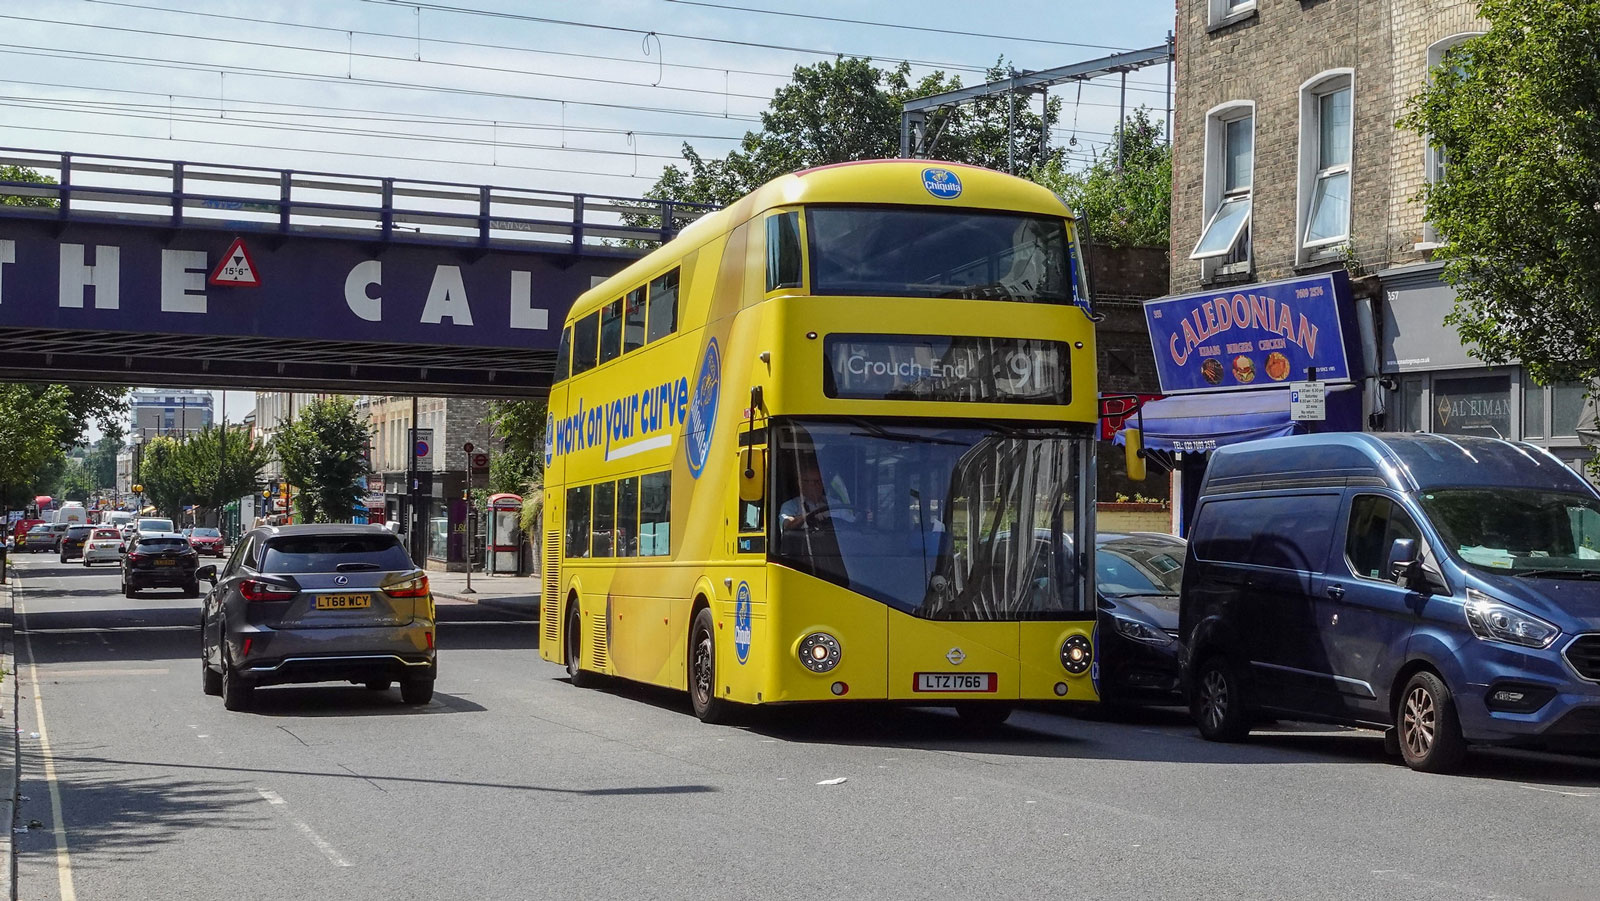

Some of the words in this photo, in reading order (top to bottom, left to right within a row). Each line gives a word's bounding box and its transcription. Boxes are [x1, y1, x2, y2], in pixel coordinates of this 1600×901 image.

[925, 181, 961, 193] Chiquita
[345, 260, 608, 330] CAL
[1170, 294, 1318, 366] CALEDONIAN
[1226, 341, 1253, 354] BURGERS
[1258, 338, 1286, 351] CHICKEN
[848, 355, 922, 377] Crouch
[930, 358, 968, 378] End
[1010, 350, 1042, 389] 91
[1451, 401, 1466, 416] AL
[556, 397, 587, 456] work
[587, 405, 603, 448] on
[605, 392, 639, 462] your
[641, 376, 688, 434] curve
[318, 597, 346, 608] LT68
[348, 596, 369, 606] WCY
[926, 676, 950, 688] LTZ
[954, 676, 980, 688] 1766
